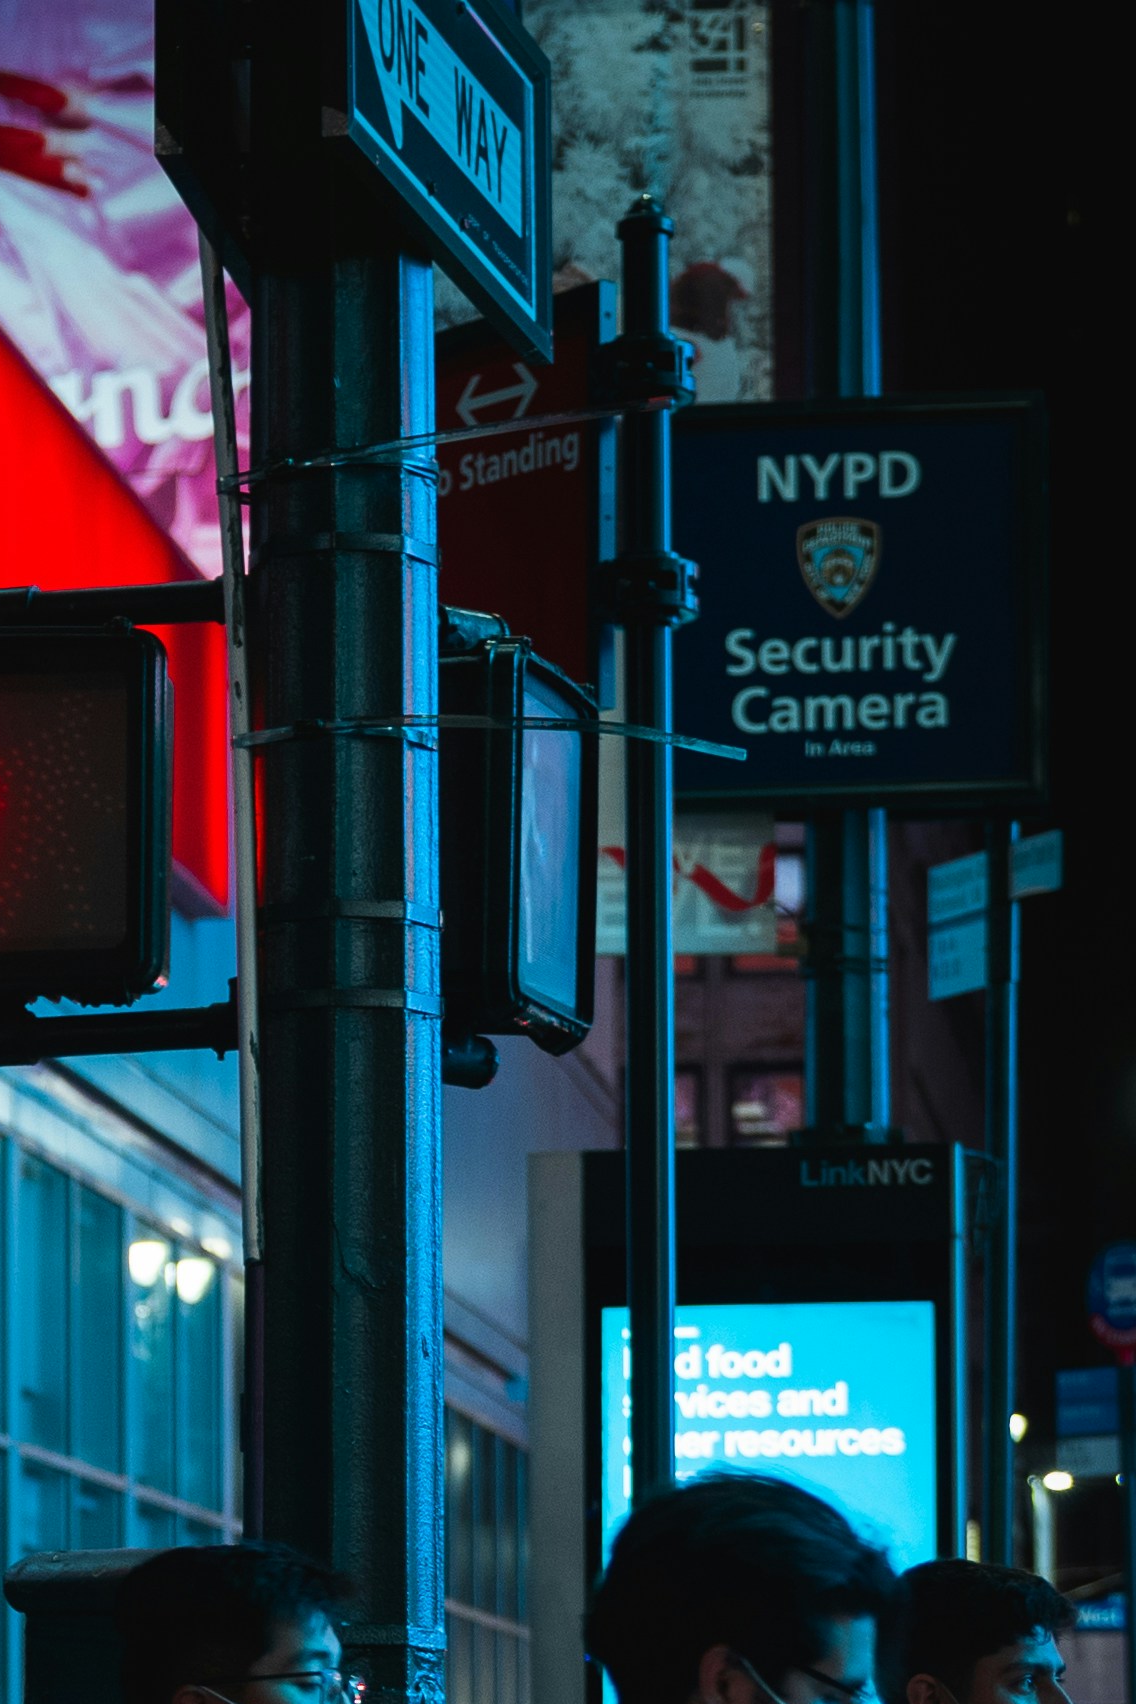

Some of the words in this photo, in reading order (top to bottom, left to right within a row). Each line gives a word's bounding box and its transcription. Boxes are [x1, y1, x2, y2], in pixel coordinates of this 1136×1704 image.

[377, 0, 430, 120] ONE
[453, 64, 508, 205] WAY
[437, 469, 453, 497] o
[458, 431, 580, 492] Standing
[756, 449, 923, 504] NYPD
[724, 620, 959, 683] Security
[731, 685, 952, 735] Camera
[826, 739, 877, 758] Area
[799, 1157, 934, 1188] LinkNYC
[706, 1343, 792, 1379] food
[776, 1380, 848, 1418] and
[723, 1427, 906, 1458] resources
